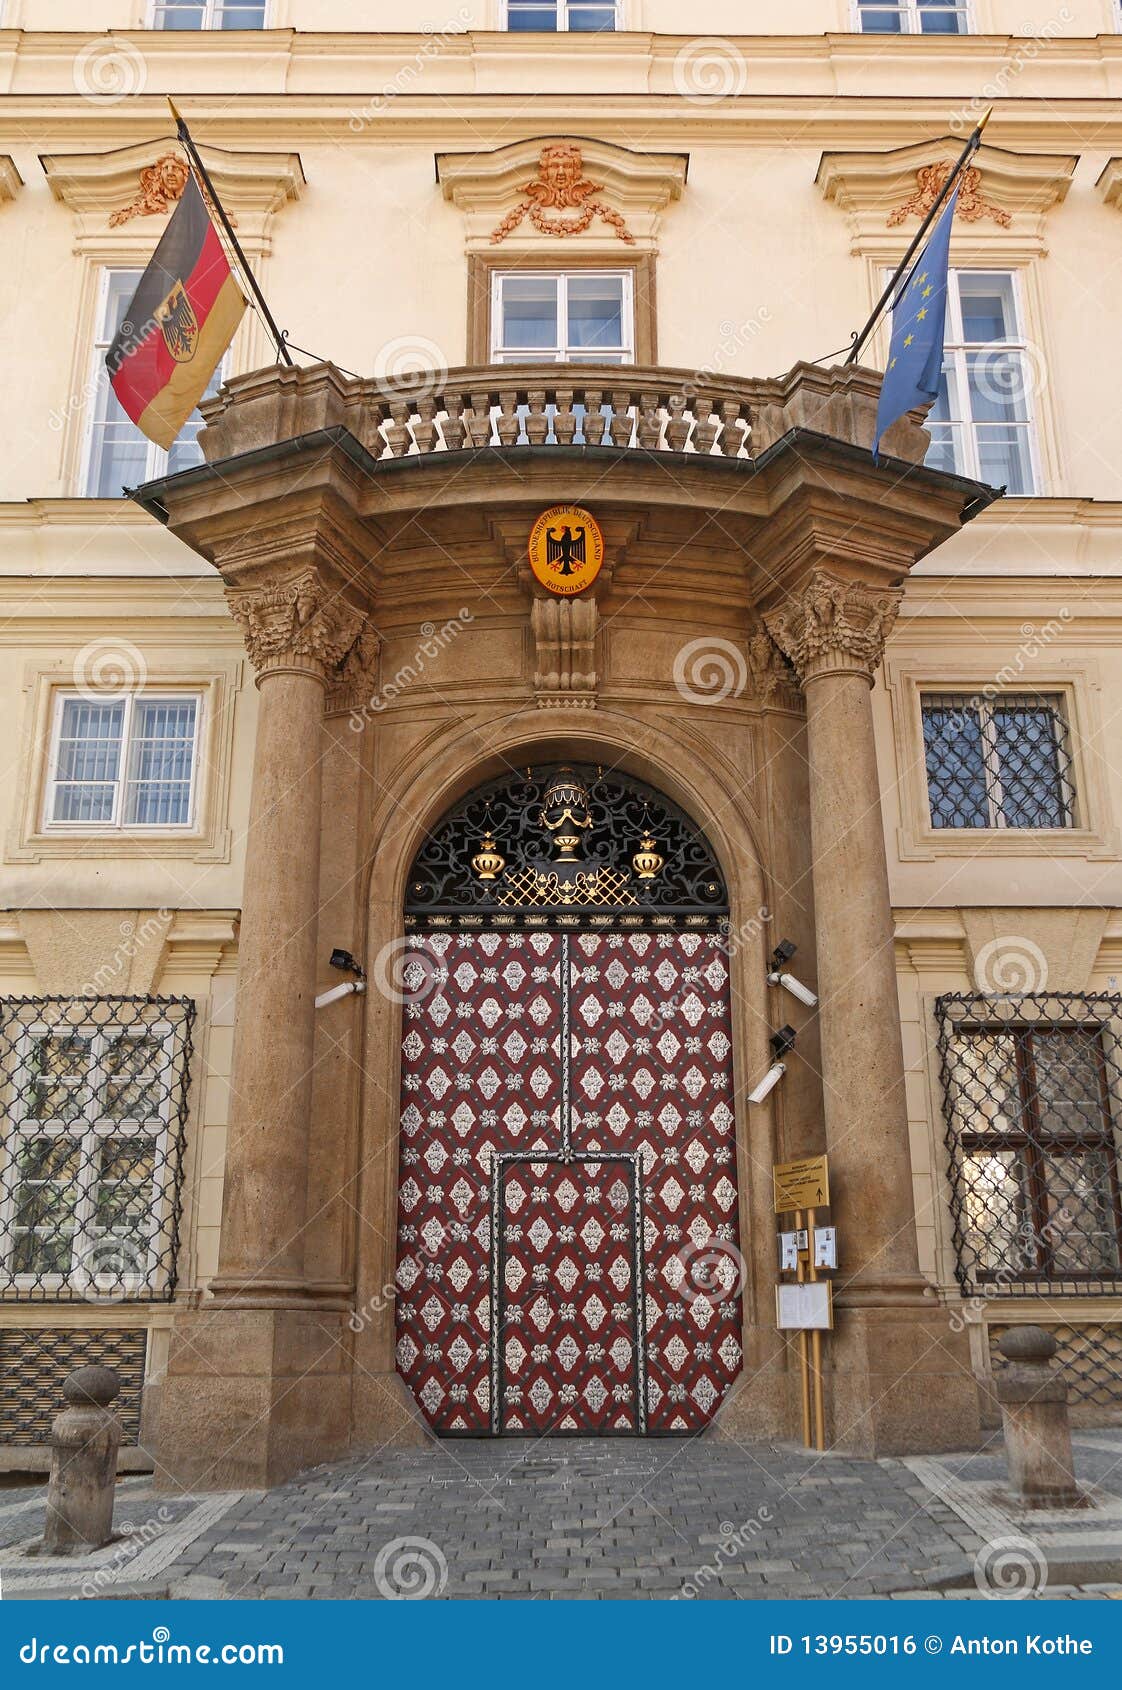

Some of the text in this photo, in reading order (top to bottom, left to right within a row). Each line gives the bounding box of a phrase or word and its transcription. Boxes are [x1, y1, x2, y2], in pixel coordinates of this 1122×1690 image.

[531, 506, 602, 563] BUNDESREPUBLIK DEUTSCHLAND
[545, 579, 588, 593] BOTSCHAFT
